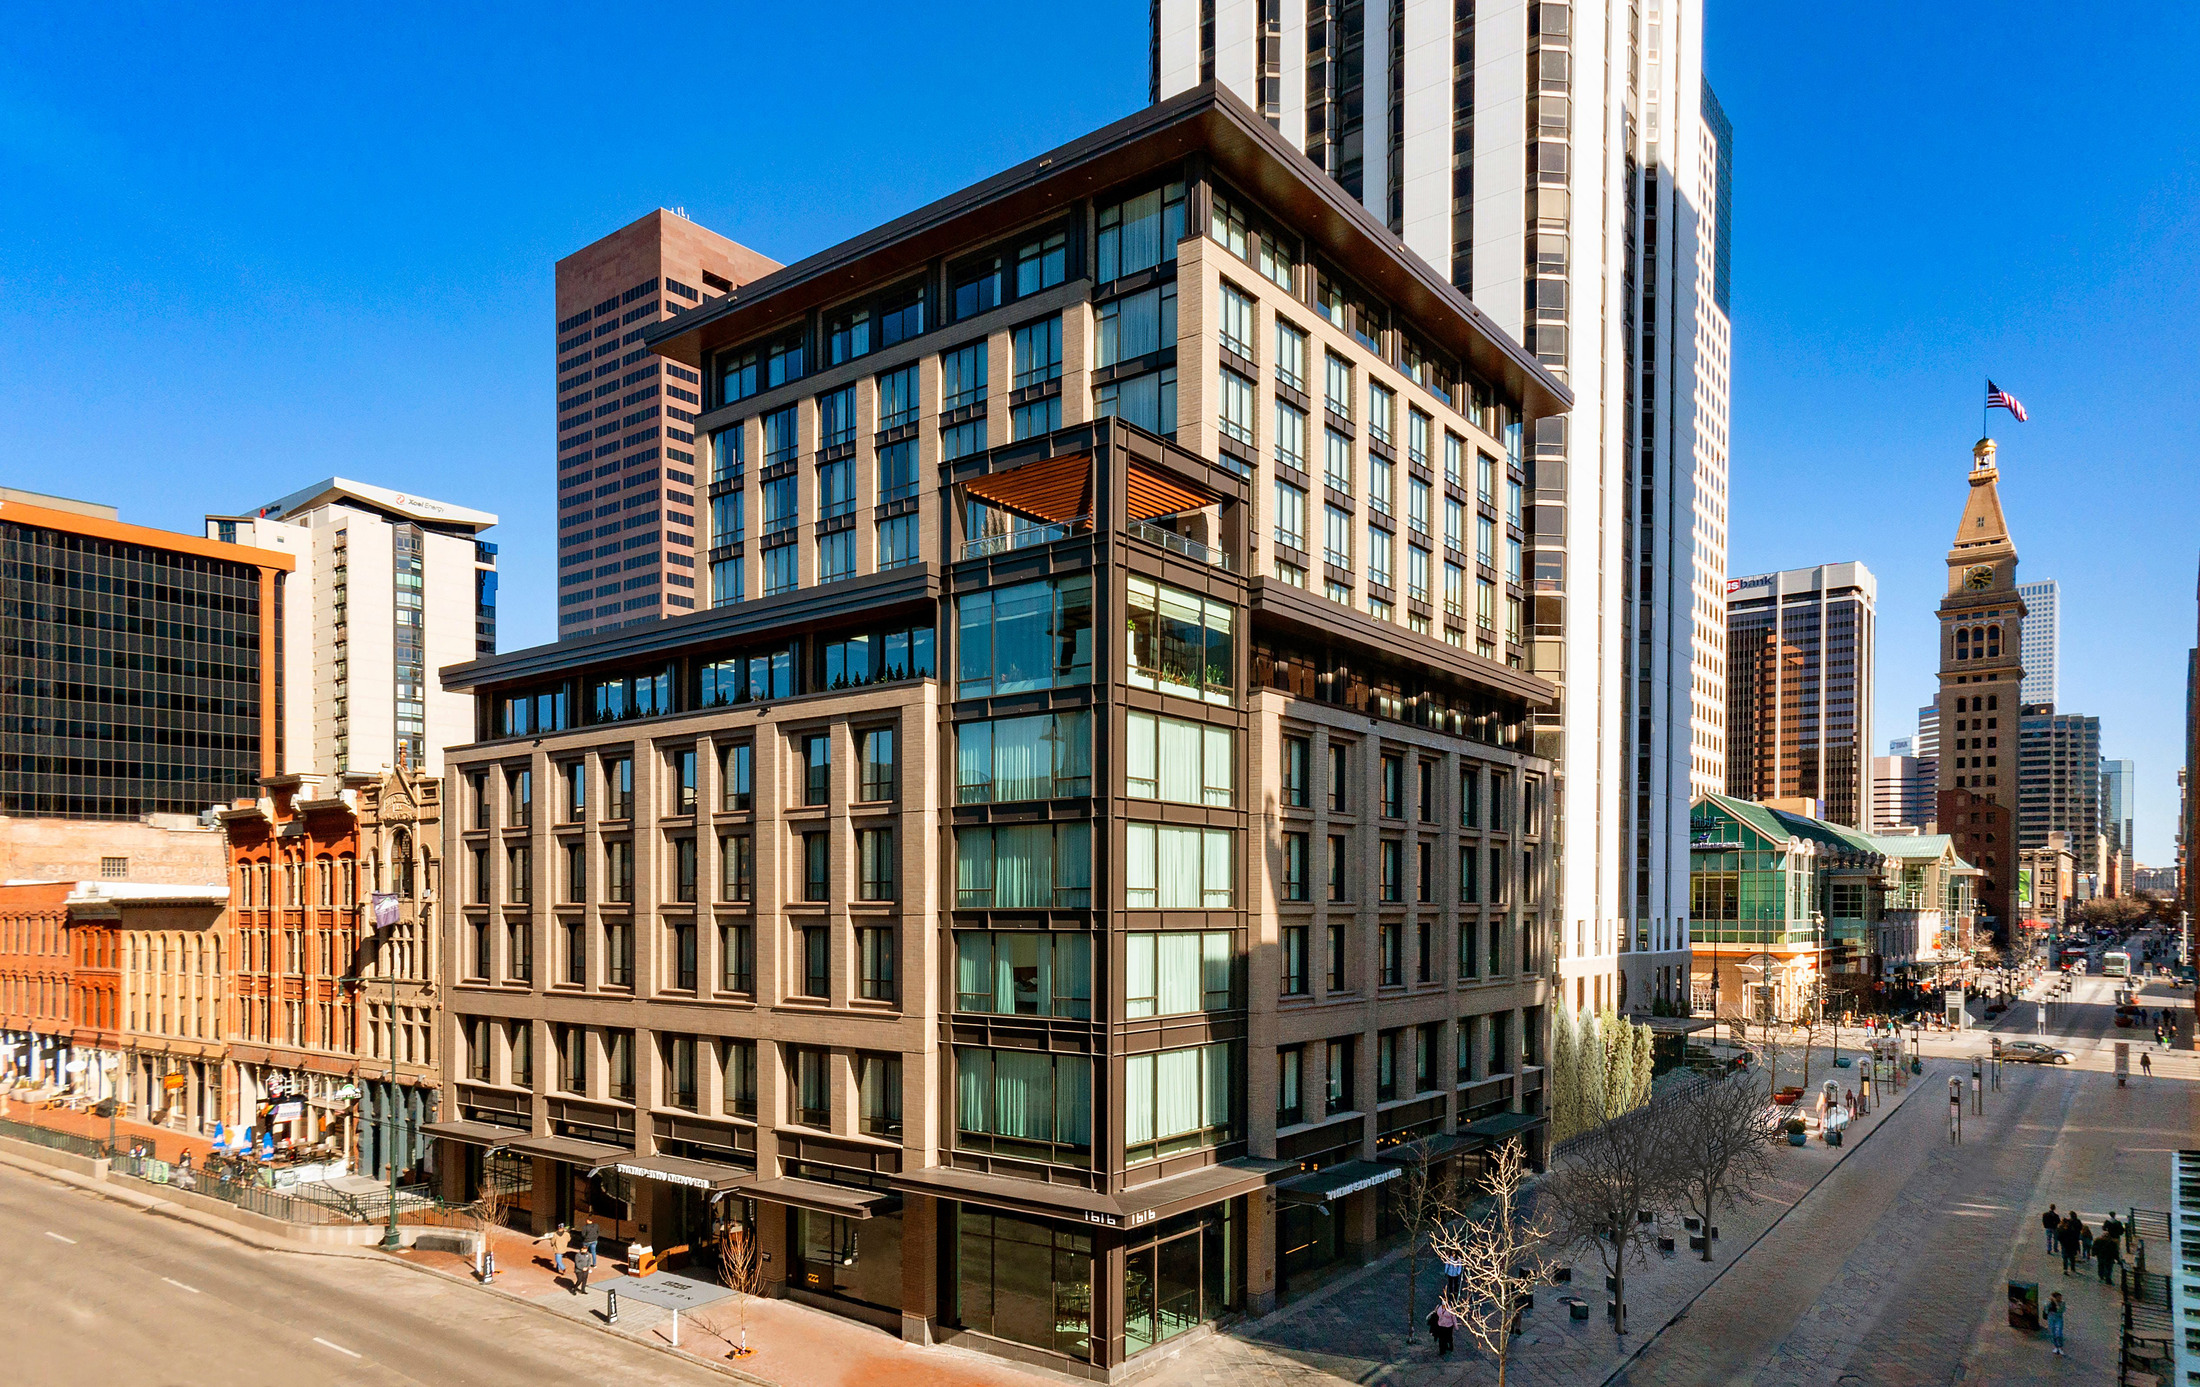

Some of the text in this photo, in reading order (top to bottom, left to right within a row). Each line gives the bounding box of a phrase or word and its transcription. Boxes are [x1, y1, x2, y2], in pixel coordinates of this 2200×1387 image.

[409, 499, 445, 513] Xcel Energy
[616, 1164, 710, 1189] THOMPSON DENVER
[1325, 1168, 1402, 1201] THOMPSON DENVER
[1085, 1210, 1116, 1226] 1616
[1131, 1209, 1156, 1226] 1616
